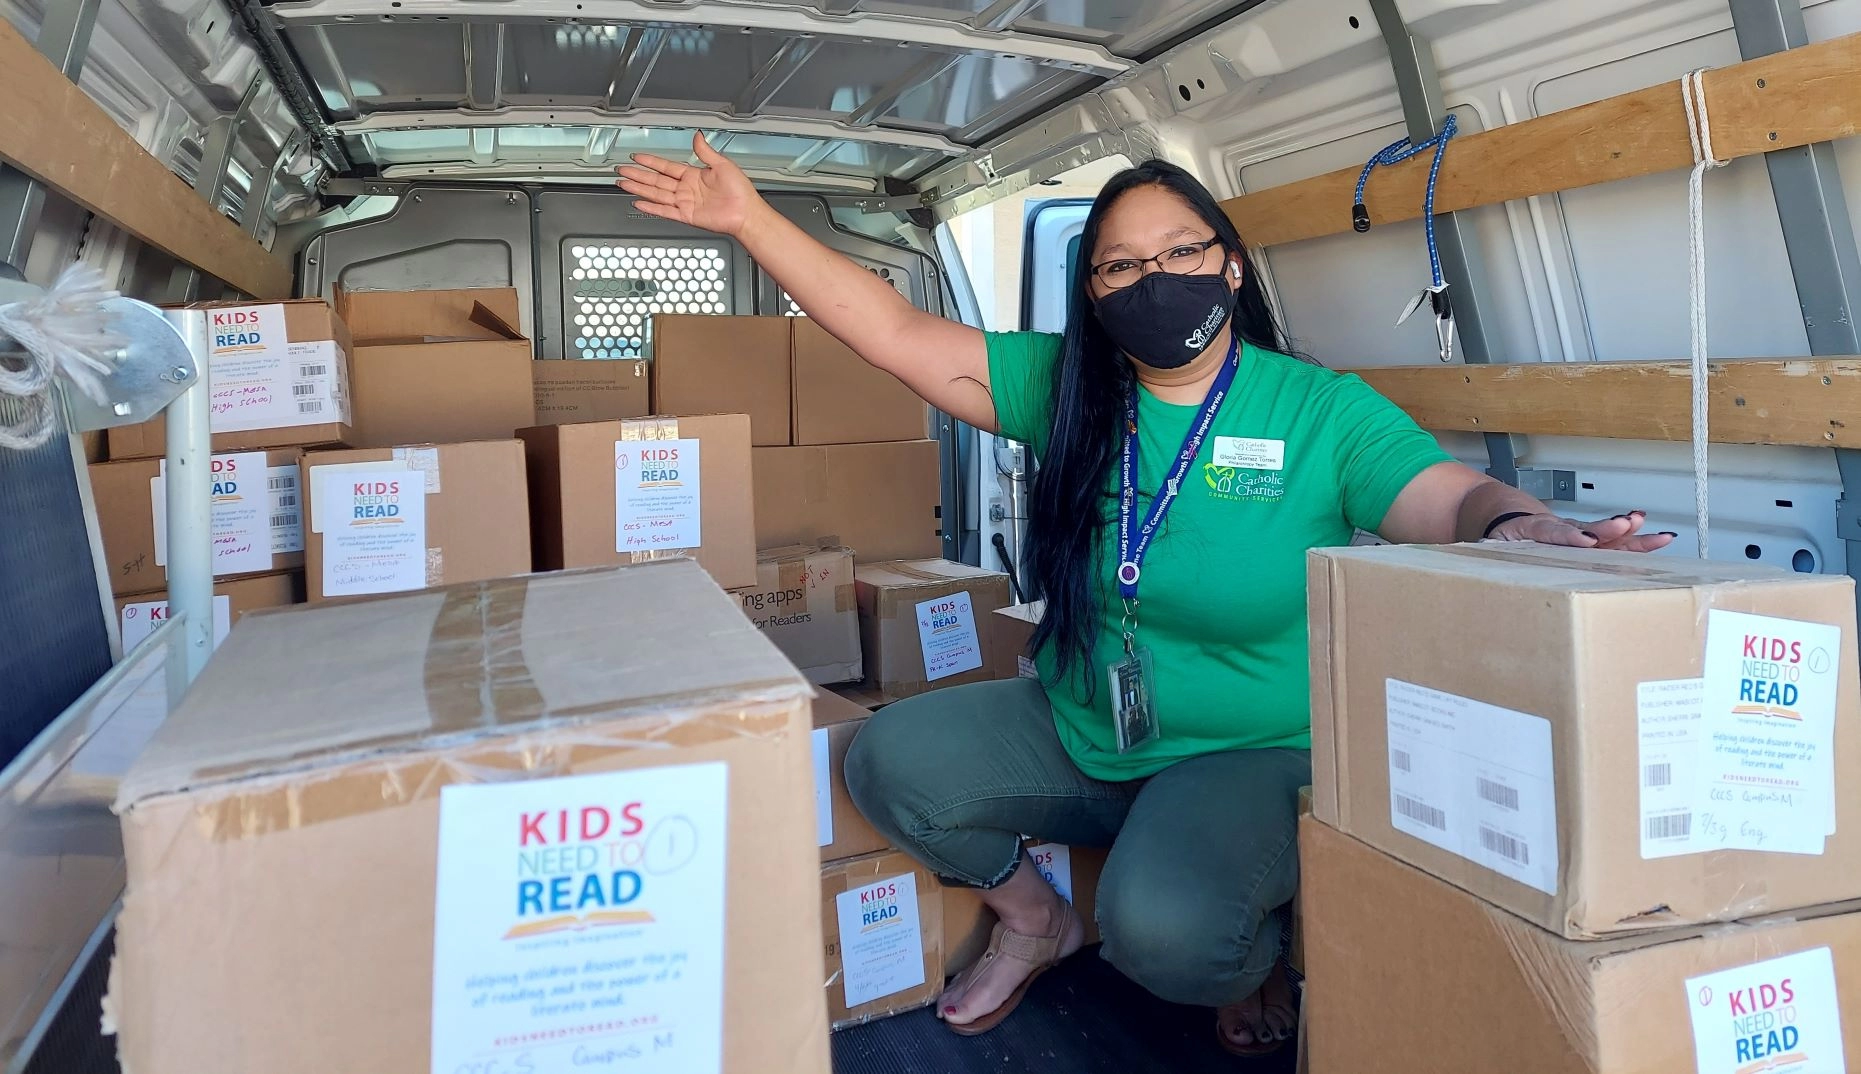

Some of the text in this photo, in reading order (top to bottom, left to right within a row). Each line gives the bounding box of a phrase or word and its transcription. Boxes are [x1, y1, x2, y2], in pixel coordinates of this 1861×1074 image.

[213, 311, 259, 325] KIDS
[1200, 303, 1220, 331] Catholic
[214, 323, 260, 335] NEED TO
[216, 332, 261, 347] READ
[641, 449, 679, 461] KIDS
[1123, 455, 1130, 463] to
[211, 459, 237, 473] DS
[641, 460, 679, 470] NEED TO
[1135, 535, 1149, 554] Team
[1196, 413, 1213, 437] Impact
[1207, 390, 1224, 415] Service
[641, 470, 679, 482] READ
[1123, 463, 1131, 487] Growth
[1237, 471, 1284, 486] Catholic
[211, 481, 238, 496] AD
[353, 481, 400, 496] KIDS
[1235, 484, 1285, 497] Charities
[353, 494, 400, 506] NEED TO
[353, 504, 400, 519] READ
[1120, 515, 1130, 538] Impact
[626, 533, 680, 547] High School
[1121, 539, 1129, 565] Servic
[800, 565, 830, 584] NOT IN
[742, 588, 803, 610] ing apps
[150, 607, 170, 620] KI
[930, 601, 955, 615] KIDS
[769, 612, 812, 628] Readers
[931, 612, 948, 621] NEED
[932, 615, 958, 629] READ
[1743, 634, 1802, 664] KIDS
[1741, 659, 1801, 683] NEED TO
[1739, 678, 1799, 707] READ
[1723, 745, 1750, 759] reading
[1750, 748, 1763, 757] and
[1777, 750, 1798, 762] power
[518, 801, 645, 848] KIDS
[516, 839, 645, 878] NEED TO
[1035, 851, 1053, 866] DS
[516, 869, 643, 917] READ
[859, 883, 897, 905] KIDS
[861, 896, 898, 915] NEED TO
[862, 905, 899, 927] READ
[1728, 978, 1795, 1019] KIDS
[1733, 1005, 1798, 1039] NEED TO
[1735, 1024, 1800, 1064] READ
